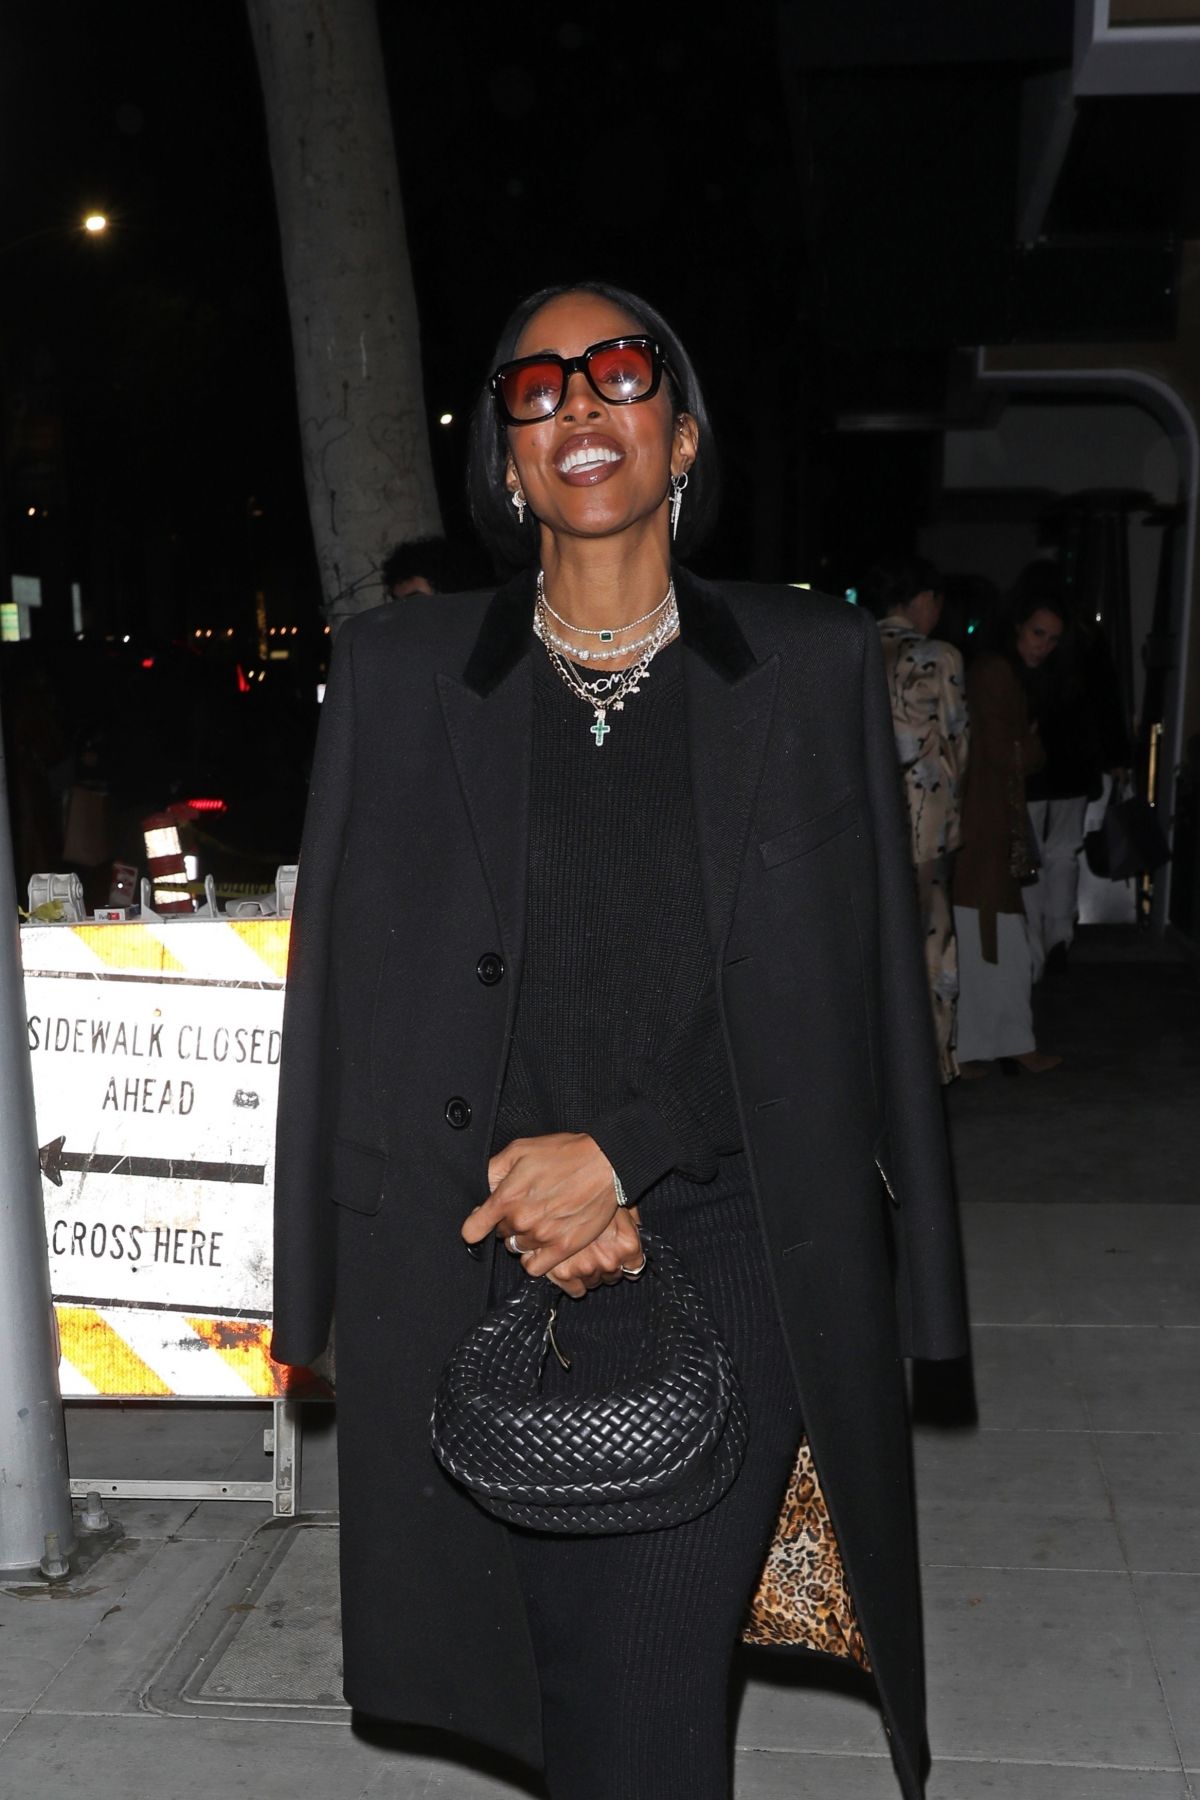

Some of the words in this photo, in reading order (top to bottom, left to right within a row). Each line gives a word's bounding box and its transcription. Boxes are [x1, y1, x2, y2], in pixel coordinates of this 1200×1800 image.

[27, 1016, 164, 1058] SIDEWALK
[178, 1025, 281, 1065] CLOSED
[102, 1077, 194, 1115] AHEAD
[53, 1220, 145, 1261] CROSS
[154, 1227, 223, 1267] HERE
